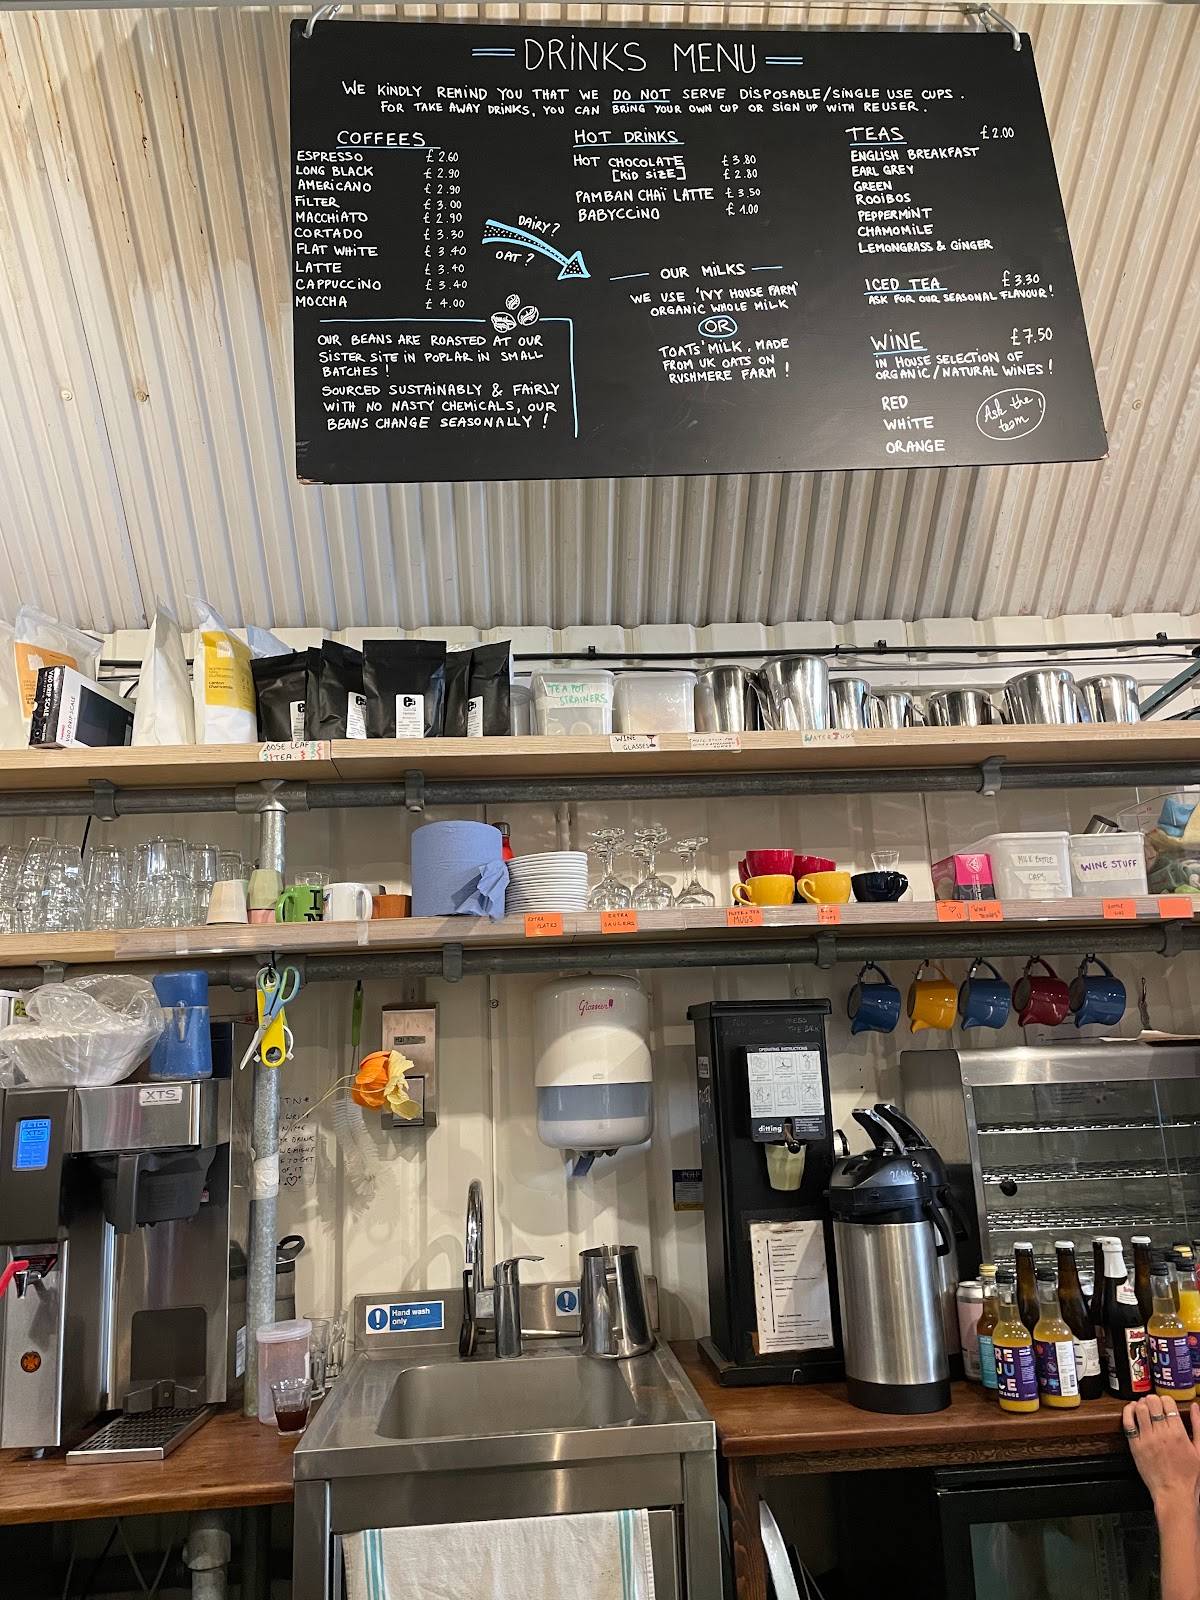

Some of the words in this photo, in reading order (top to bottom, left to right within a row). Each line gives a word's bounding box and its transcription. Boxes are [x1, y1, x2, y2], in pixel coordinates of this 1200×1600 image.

[525, 35, 646, 72] DRINKS
[674, 43, 755, 73] MENU
[342, 80, 366, 95] WE
[378, 83, 422, 97] KINDLY
[437, 85, 487, 100] REMIND
[497, 88, 522, 100] YOU
[532, 89, 569, 100] THAT
[579, 89, 598, 100] WE
[613, 89, 631, 100] DO
[641, 89, 671, 102] NOT
[683, 88, 726, 99] SERVE
[887, 89, 913, 99] USE
[381, 101, 404, 112] FOR
[413, 102, 443, 112] TAKE
[449, 102, 480, 113] AWAY
[543, 106, 564, 115] YOU
[575, 105, 599, 115] CAN
[612, 101, 645, 114] BRING
[654, 105, 682, 114] YOUR
[689, 104, 712, 113] OWN
[720, 104, 738, 112] CUP
[748, 104, 763, 112] OR
[772, 102, 800, 112] SIGN
[806, 104, 818, 112] UP
[826, 103, 854, 112] WITH
[337, 131, 425, 146] COFFEES
[575, 129, 611, 143] HOT
[621, 127, 681, 145] DRINKS
[845, 127, 904, 141] TEAS
[297, 150, 363, 162] ESPRESSO
[573, 154, 600, 167] HOT
[609, 155, 685, 169] CHOCOLATE
[851, 150, 899, 162] ENGLISH
[907, 147, 979, 160] BREAKFAST
[296, 165, 325, 175] LONG
[332, 166, 373, 176] BLACK
[852, 166, 879, 177] EARL
[883, 165, 913, 175] GREY
[298, 179, 371, 192] AMERICANO
[854, 181, 892, 192] GREEN
[295, 195, 340, 208] FILTER
[576, 189, 633, 203] PAMBAN
[673, 188, 714, 202] LATTE
[855, 193, 911, 205] ROOIBOS
[296, 210, 368, 223] MACCHIATO
[578, 206, 660, 222] BABYCCINO
[858, 206, 932, 222] PEPPERMINT
[294, 227, 362, 239] CORTADO
[858, 223, 933, 237] CHAMOMILE
[297, 243, 328, 255] FLAT
[333, 244, 378, 256] WHITE
[858, 242, 934, 253] LEMONGRASS
[936, 240, 946, 251] &
[950, 239, 993, 250] GINGER
[296, 261, 342, 273] LATTE
[660, 267, 689, 279] OUR
[701, 261, 746, 277] MILKS
[296, 278, 381, 290] CAPPUCCINO
[865, 278, 899, 293] ICED
[909, 277, 944, 292] TEA
[296, 296, 347, 308] MOCCHA
[630, 293, 651, 304] WE
[661, 292, 685, 302] USE
[729, 287, 763, 299] HOUSE
[864, 292, 888, 305] ASK
[894, 294, 915, 303] FOR
[919, 295, 941, 303] OUR
[943, 292, 997, 302] SEASONAL
[650, 302, 706, 316] ORGANIC
[710, 302, 747, 312] WHOLE
[754, 299, 789, 310] MILK
[703, 316, 735, 335] OR
[317, 334, 342, 346] OUR
[351, 333, 392, 345] BEANS
[398, 334, 421, 345] ARE
[431, 335, 486, 346] ROASTED
[493, 335, 511, 346] AT
[518, 335, 543, 346] OUR
[755, 338, 789, 350] MADE
[871, 330, 922, 351] WINE
[319, 350, 366, 363] SISTER
[370, 351, 399, 362] SITE
[404, 350, 415, 363] IN
[424, 351, 473, 362] POPLAR
[478, 350, 490, 362] IN
[501, 351, 543, 361] SMALL
[663, 359, 693, 371] FROM
[699, 358, 716, 368] UK
[722, 356, 751, 368] OATS
[758, 354, 775, 365] ON
[876, 358, 887, 368] IN
[895, 355, 931, 368] HOUSE
[936, 352, 1000, 364] SELECTION
[1007, 351, 1023, 361] OF
[669, 370, 732, 384] RUSHMERE
[322, 385, 381, 396] SOURCED
[389, 382, 482, 396] SUSTAINABLY
[492, 383, 503, 397] &
[513, 381, 559, 396] FAIRLY
[323, 399, 356, 412] WITH
[366, 401, 382, 412] NO
[392, 400, 434, 412] NASTY
[528, 402, 557, 412] OUR
[882, 395, 908, 411] RED
[984, 400, 1007, 423] Ask
[1010, 394, 1033, 409] the
[327, 418, 368, 431] BEANS
[375, 416, 430, 429] CHANGE
[883, 416, 934, 430] WHITE
[1000, 412, 1029, 432] team
[886, 439, 945, 453] ORANGE
[560, 693, 608, 705] STRAINERS
[1081, 860, 1108, 872] WINE
[1111, 859, 1137, 869] STUFF
[146, 1090, 176, 1100] XTS
[391, 1309, 411, 1317] Hand
[412, 1307, 431, 1316] wash
[391, 1318, 408, 1326] only
